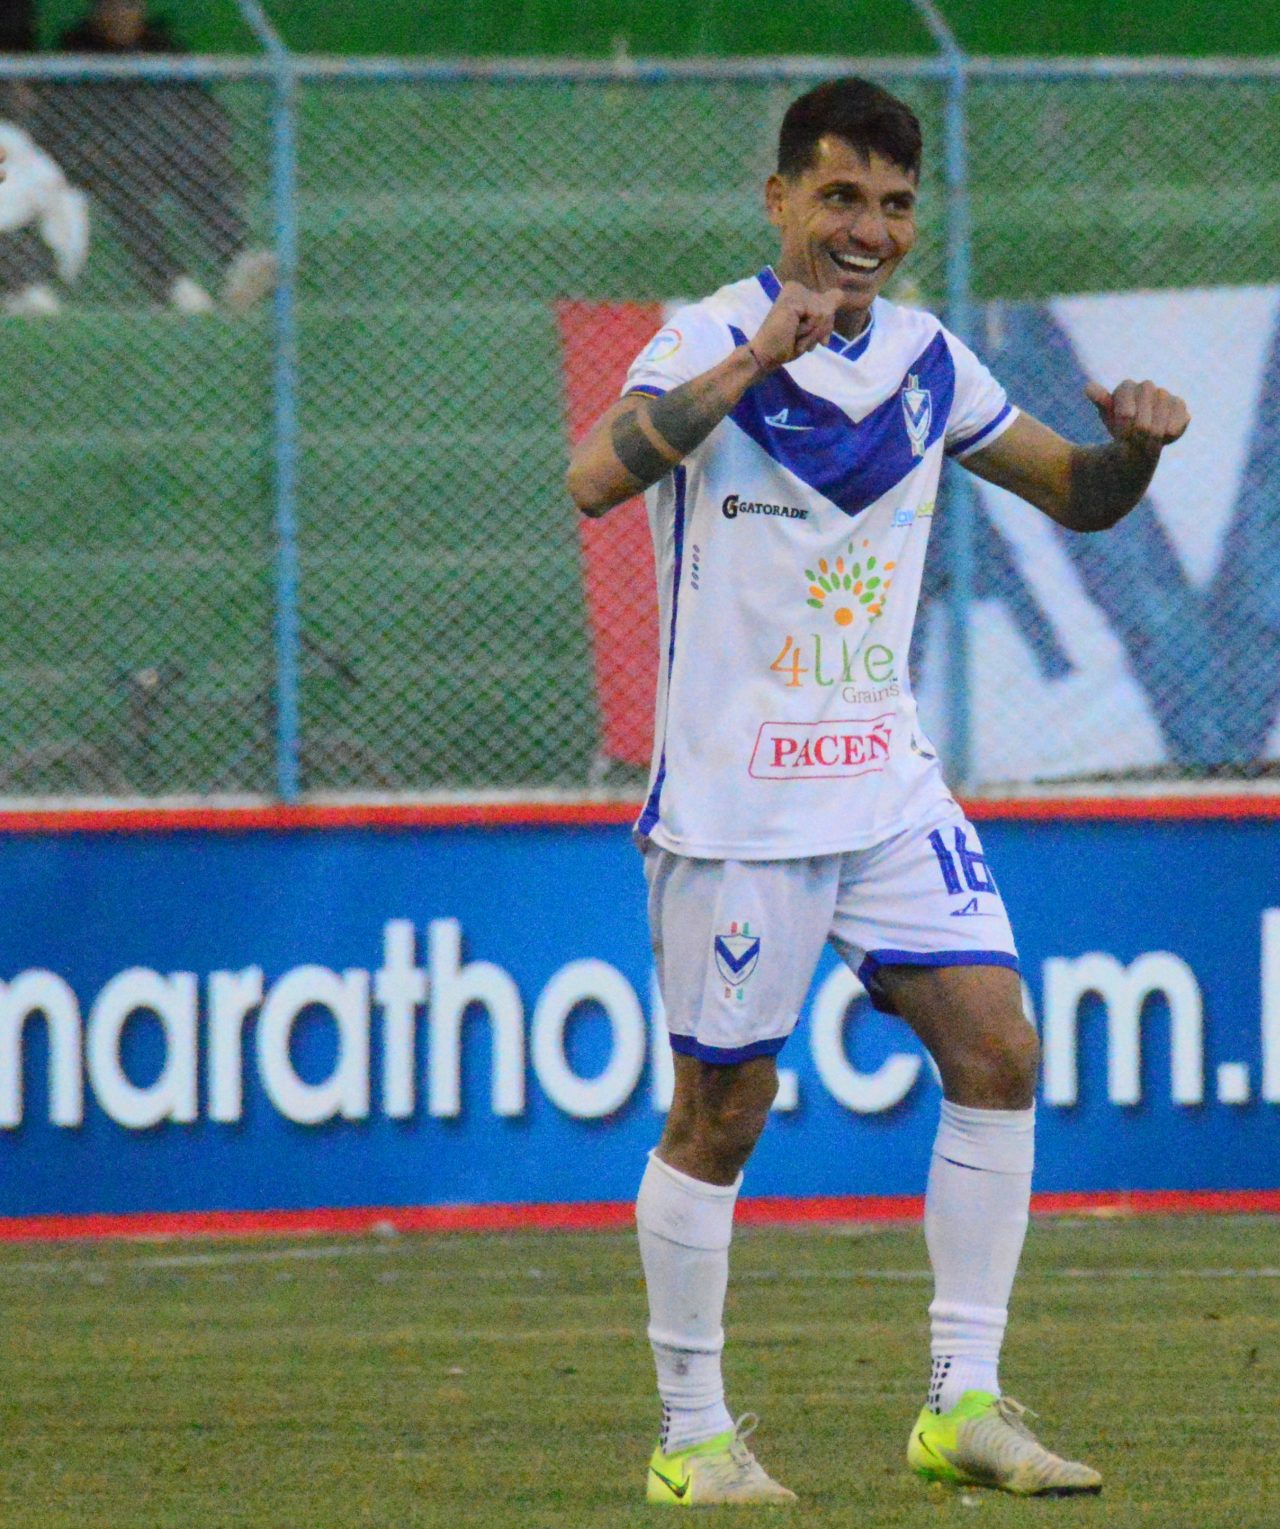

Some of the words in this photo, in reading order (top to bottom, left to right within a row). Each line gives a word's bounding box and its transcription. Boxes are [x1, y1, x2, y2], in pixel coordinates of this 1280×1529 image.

[739, 502, 809, 520] GATORADE
[770, 633, 895, 689] 4lie
[842, 683, 900, 706] Grains
[770, 723, 892, 768] PACEÑ
[927, 826, 998, 896] 16
